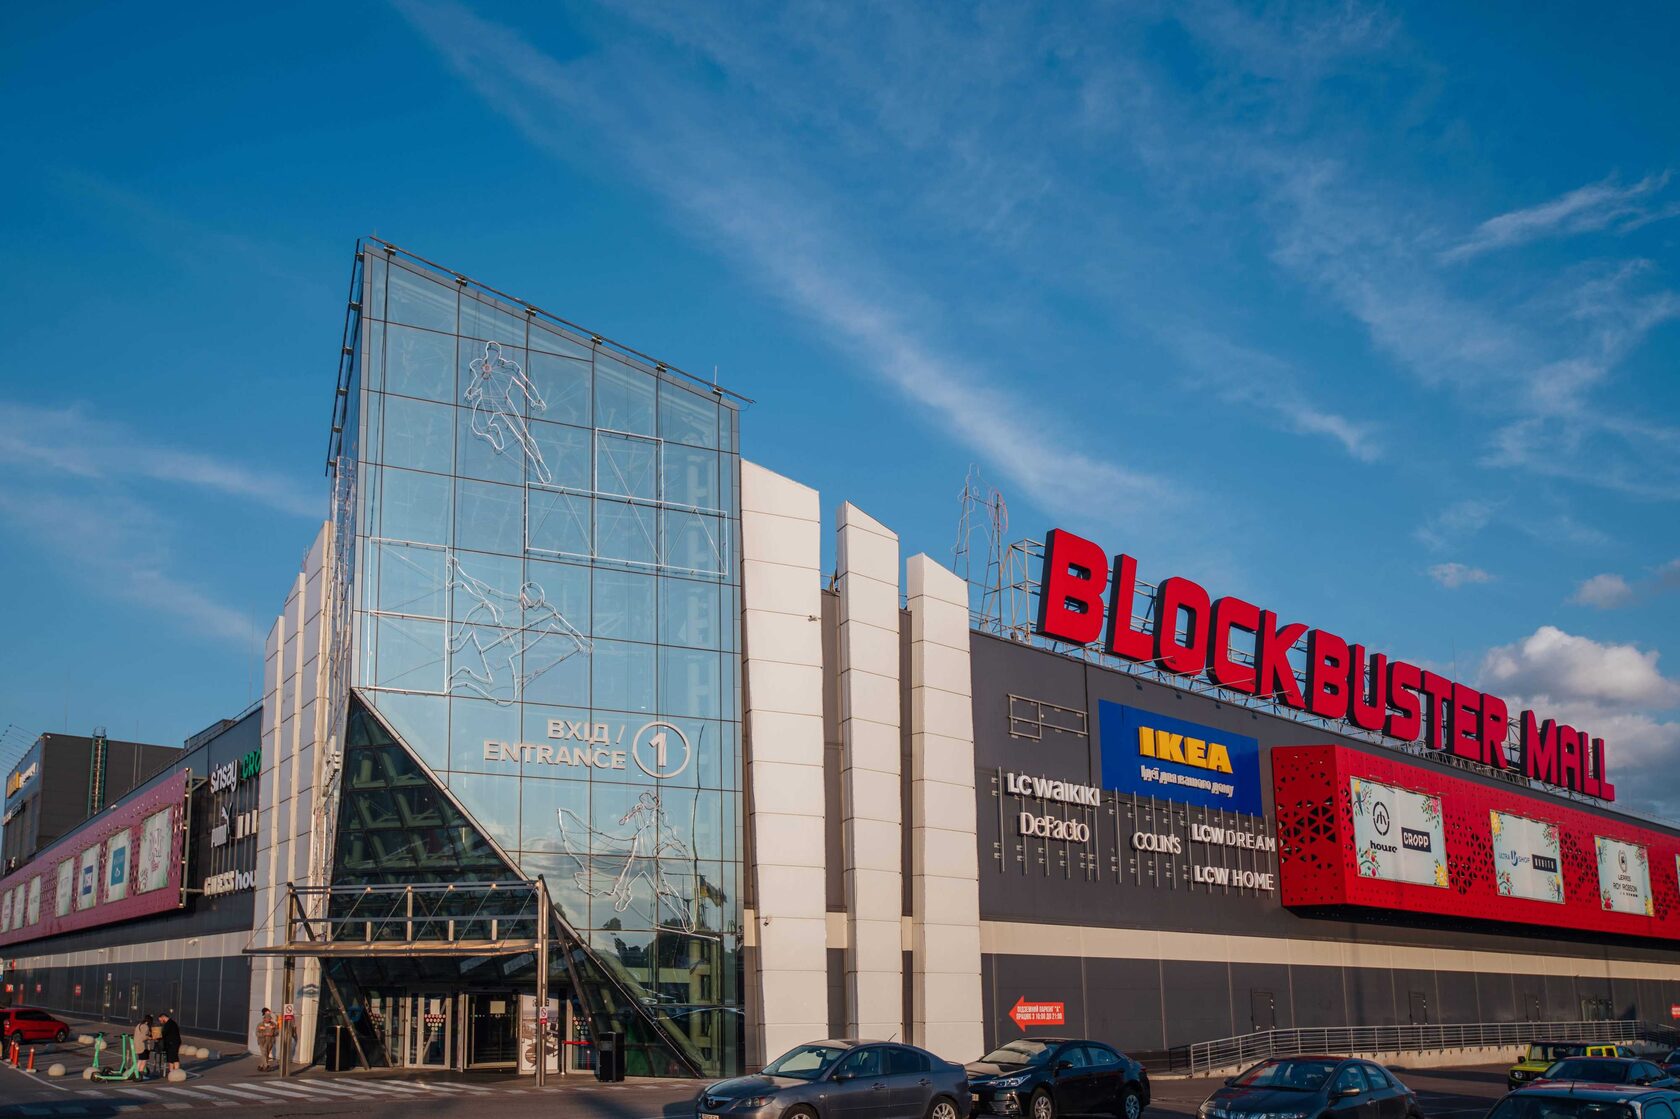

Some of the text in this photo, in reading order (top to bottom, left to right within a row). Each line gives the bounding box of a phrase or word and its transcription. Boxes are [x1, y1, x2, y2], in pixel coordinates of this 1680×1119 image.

[1037, 528, 1615, 801] BLOCKBUSTER MALL
[547, 719, 625, 746] ВХІД /
[483, 739, 627, 770] ENTRANCE
[649, 732, 667, 768] 1
[1139, 726, 1233, 774] IKEA
[210, 759, 238, 794] sinsay
[1140, 765, 1159, 782] Ідеї
[1211, 782, 1234, 798] дому
[1020, 812, 1090, 842] DeFacto
[1191, 823, 1276, 852] LCW DREAM
[1403, 831, 1429, 848] CROPP
[1133, 832, 1182, 855] COLIN'S
[1193, 865, 1275, 891] LCW HOME
